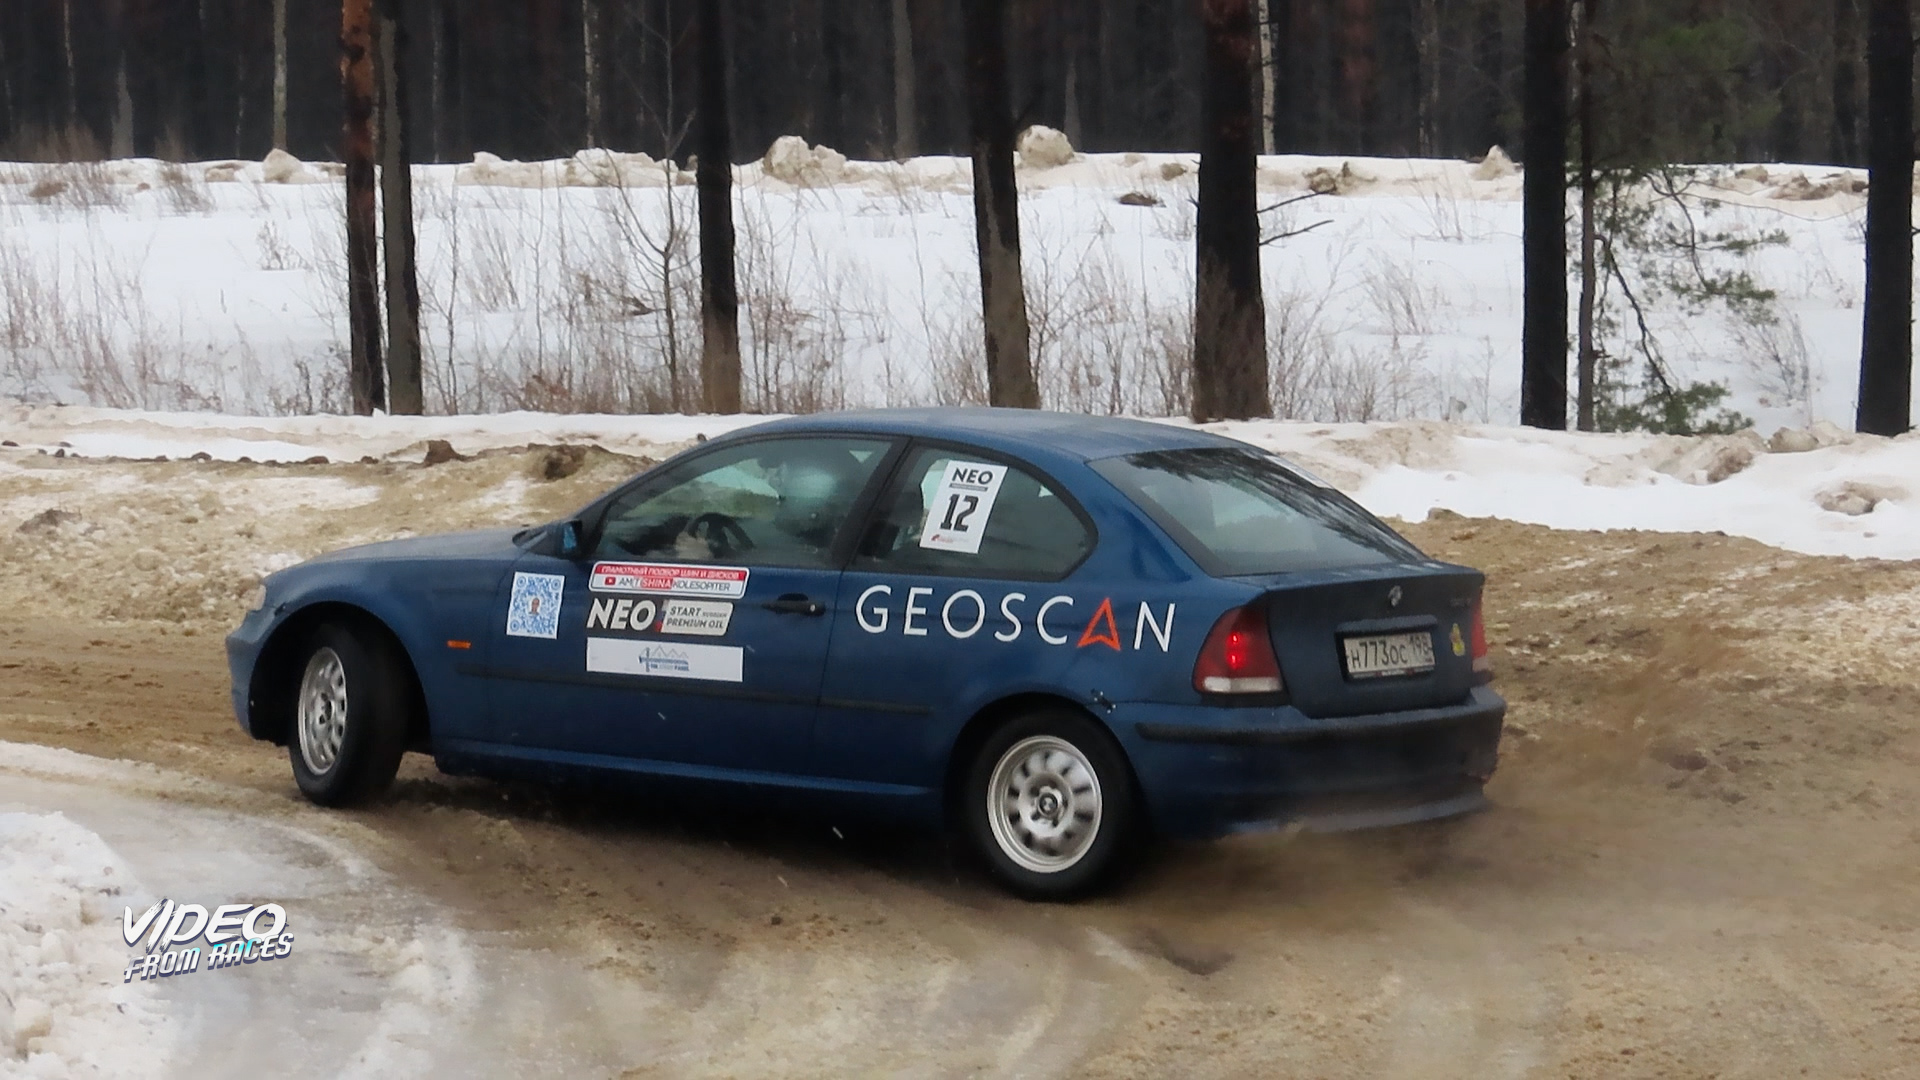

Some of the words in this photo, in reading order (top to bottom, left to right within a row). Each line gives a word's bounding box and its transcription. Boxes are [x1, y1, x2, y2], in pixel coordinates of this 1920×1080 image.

[951, 467, 993, 485] NEO
[940, 494, 979, 532] 12
[586, 597, 656, 631] NEO
[666, 618, 707, 628] PREMIUM
[708, 620, 725, 629] OIL
[669, 606, 701, 617] START
[855, 584, 1176, 652] GEOSCAN
